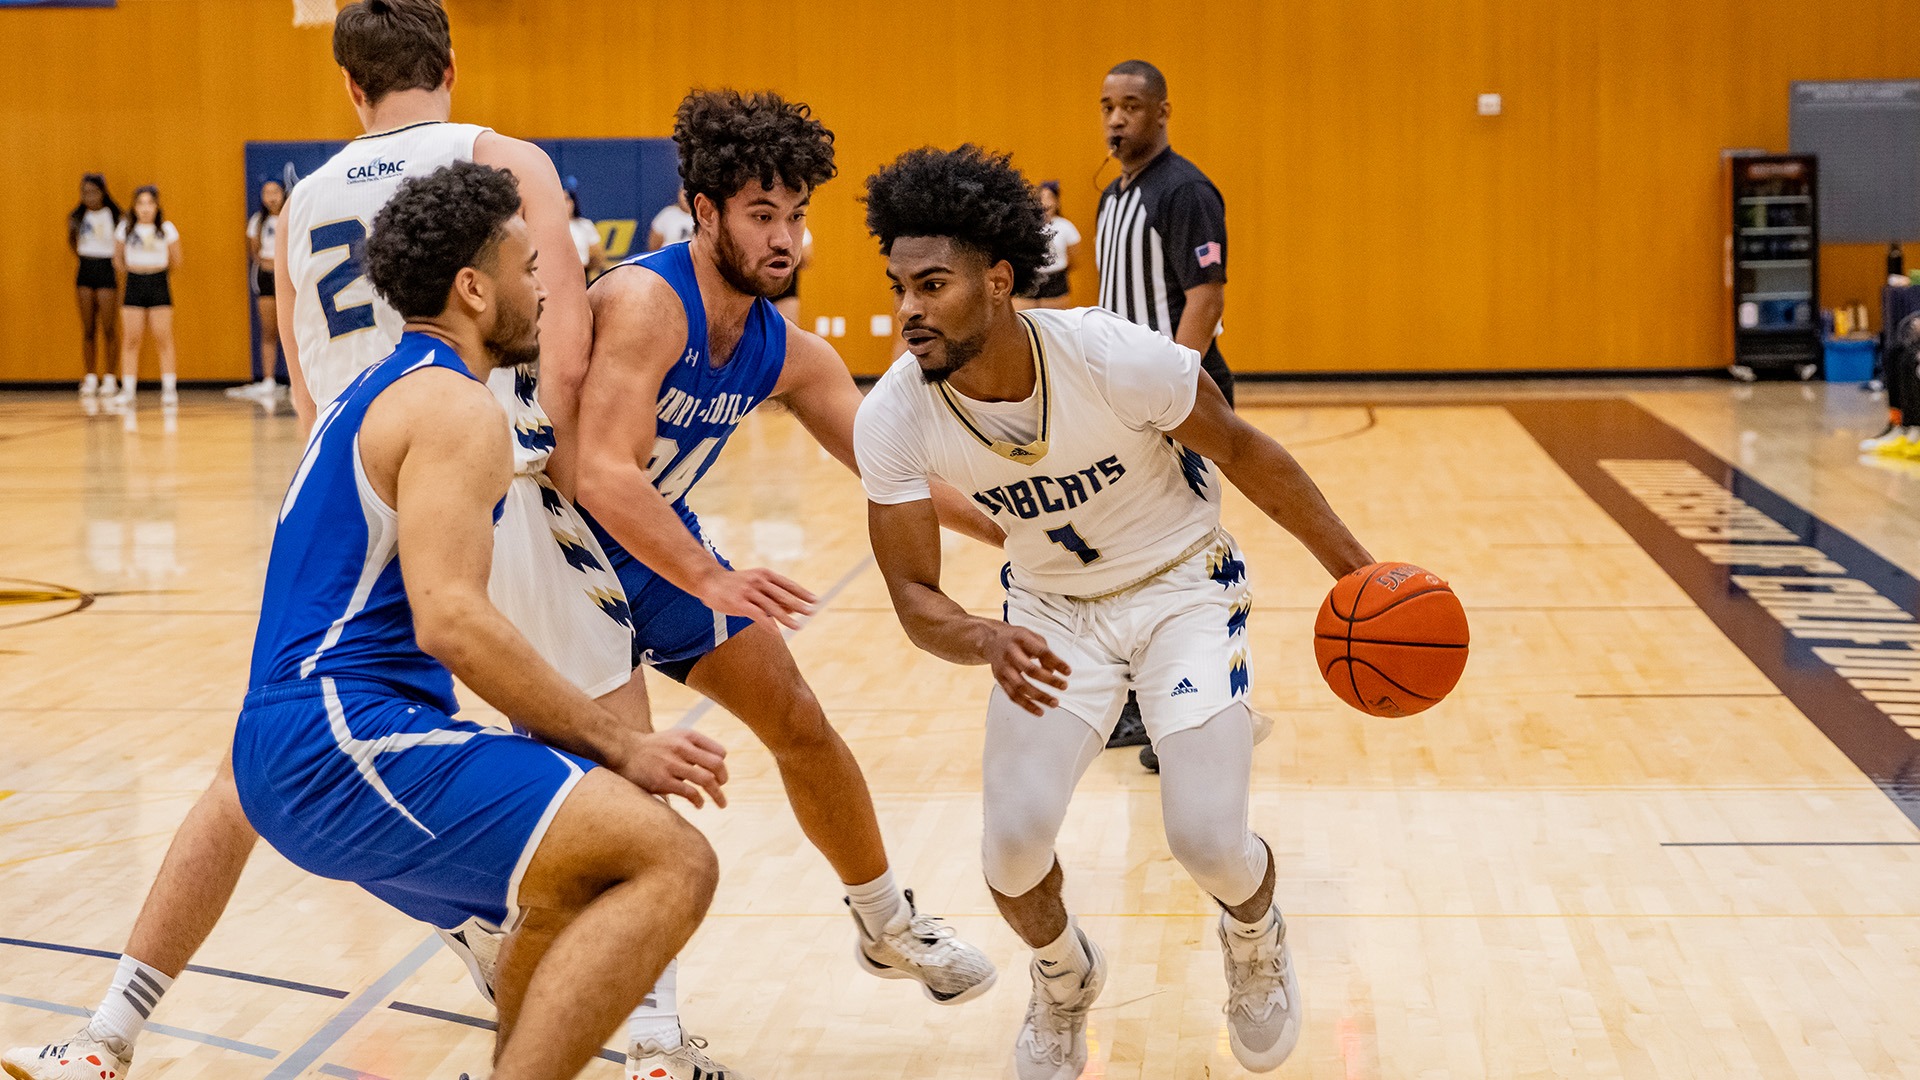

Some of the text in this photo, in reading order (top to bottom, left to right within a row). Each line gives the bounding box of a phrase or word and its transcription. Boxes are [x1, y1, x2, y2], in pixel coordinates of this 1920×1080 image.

[347, 160, 406, 179] CAL PAC
[1043, 521, 1103, 567] 1
